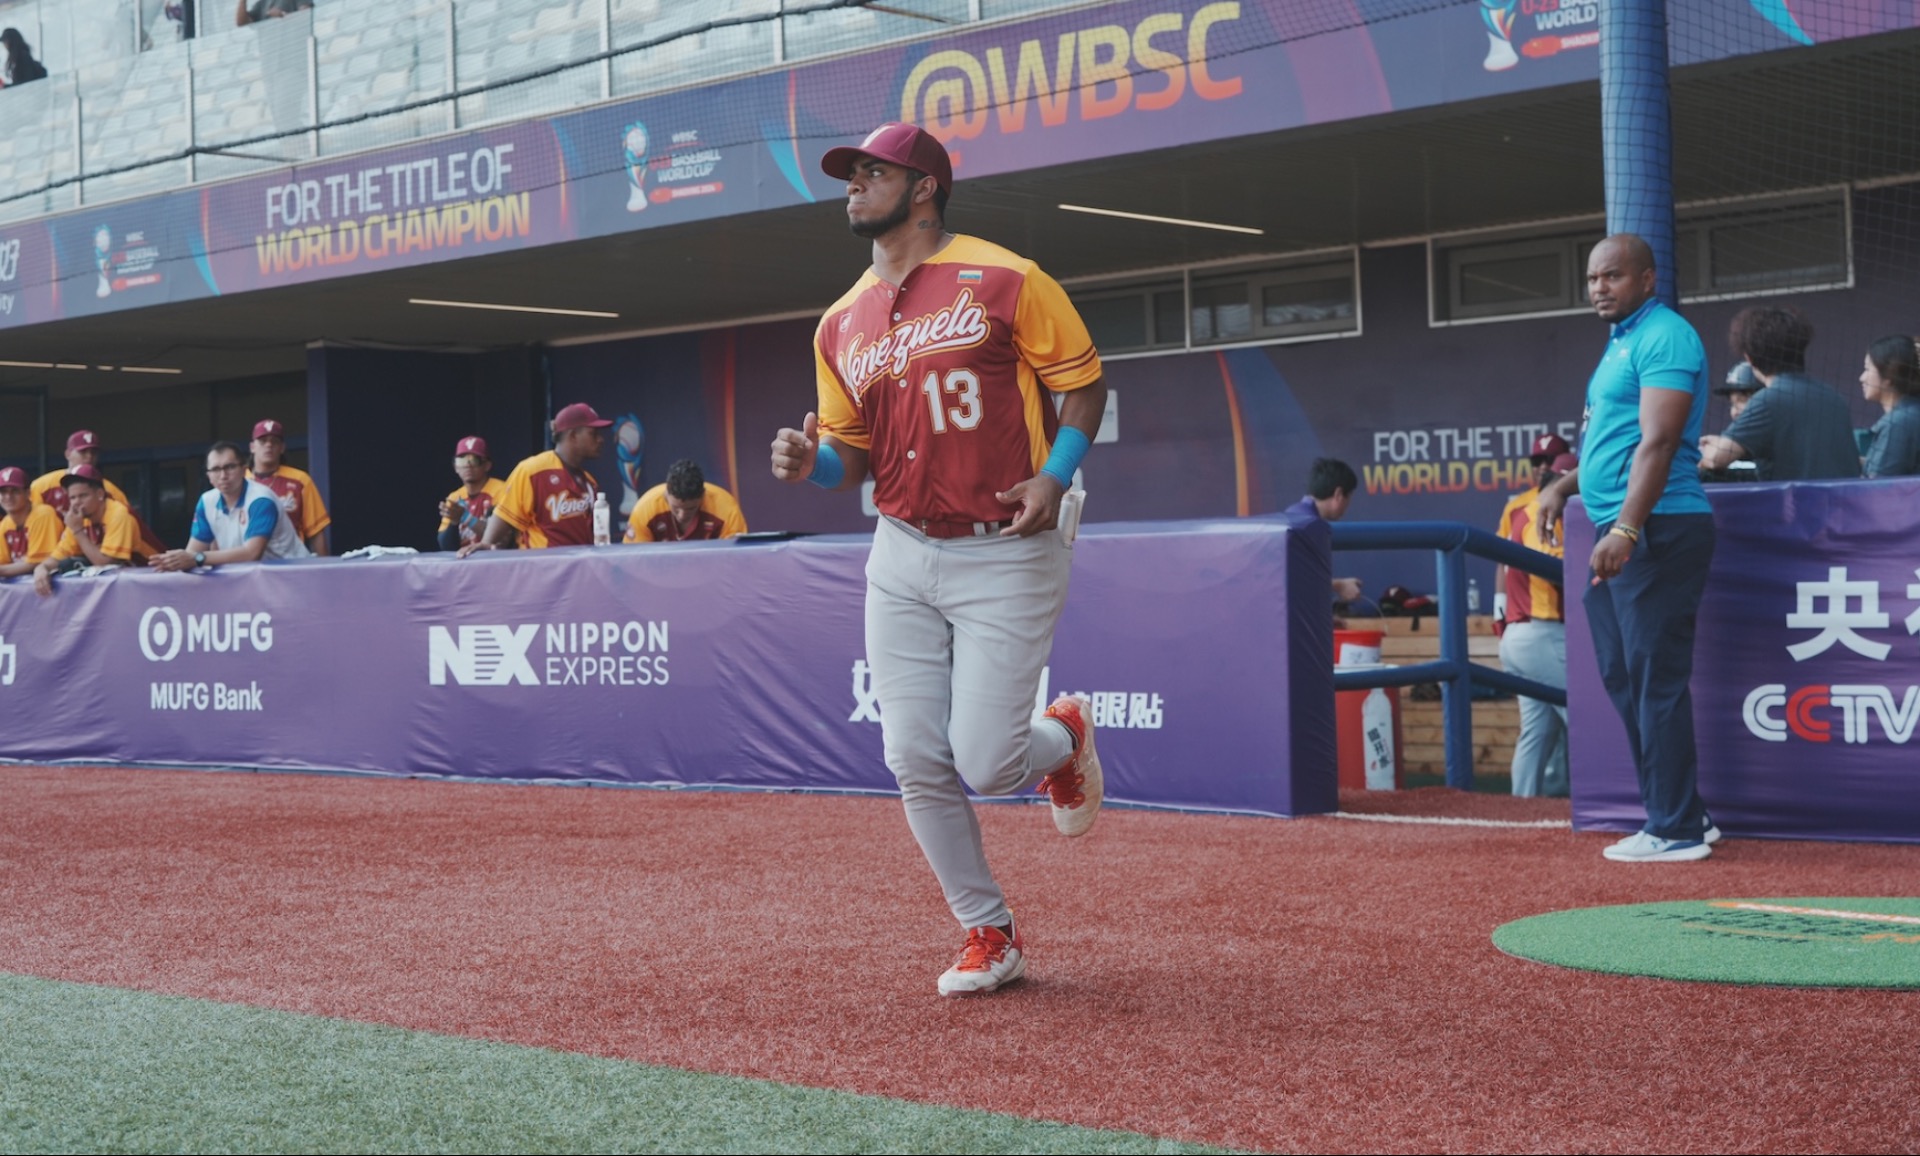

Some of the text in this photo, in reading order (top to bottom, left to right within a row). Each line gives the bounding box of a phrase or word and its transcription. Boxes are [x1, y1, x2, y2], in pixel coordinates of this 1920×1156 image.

[1535, 5, 1597, 31] WORLD
[901, 2, 1243, 144] @WBSC
[266, 143, 514, 229] FOR THE TITLE OF
[657, 166, 693, 183] WORLD
[256, 192, 530, 276] WORLD CHAMPION
[838, 287, 991, 407] Venezuela
[921, 367, 984, 435] 13
[1373, 430, 1430, 463] FOR
[1433, 426, 1492, 459] THE
[1362, 460, 1470, 495] WORLD
[187, 612, 274, 653] MUFG
[1785, 566, 1920, 662] 央
[546, 621, 669, 653] NIPPON
[546, 656, 670, 686] EXPRESS
[150, 681, 263, 711] MUFG Bank
[1742, 684, 1920, 744] CCTV
